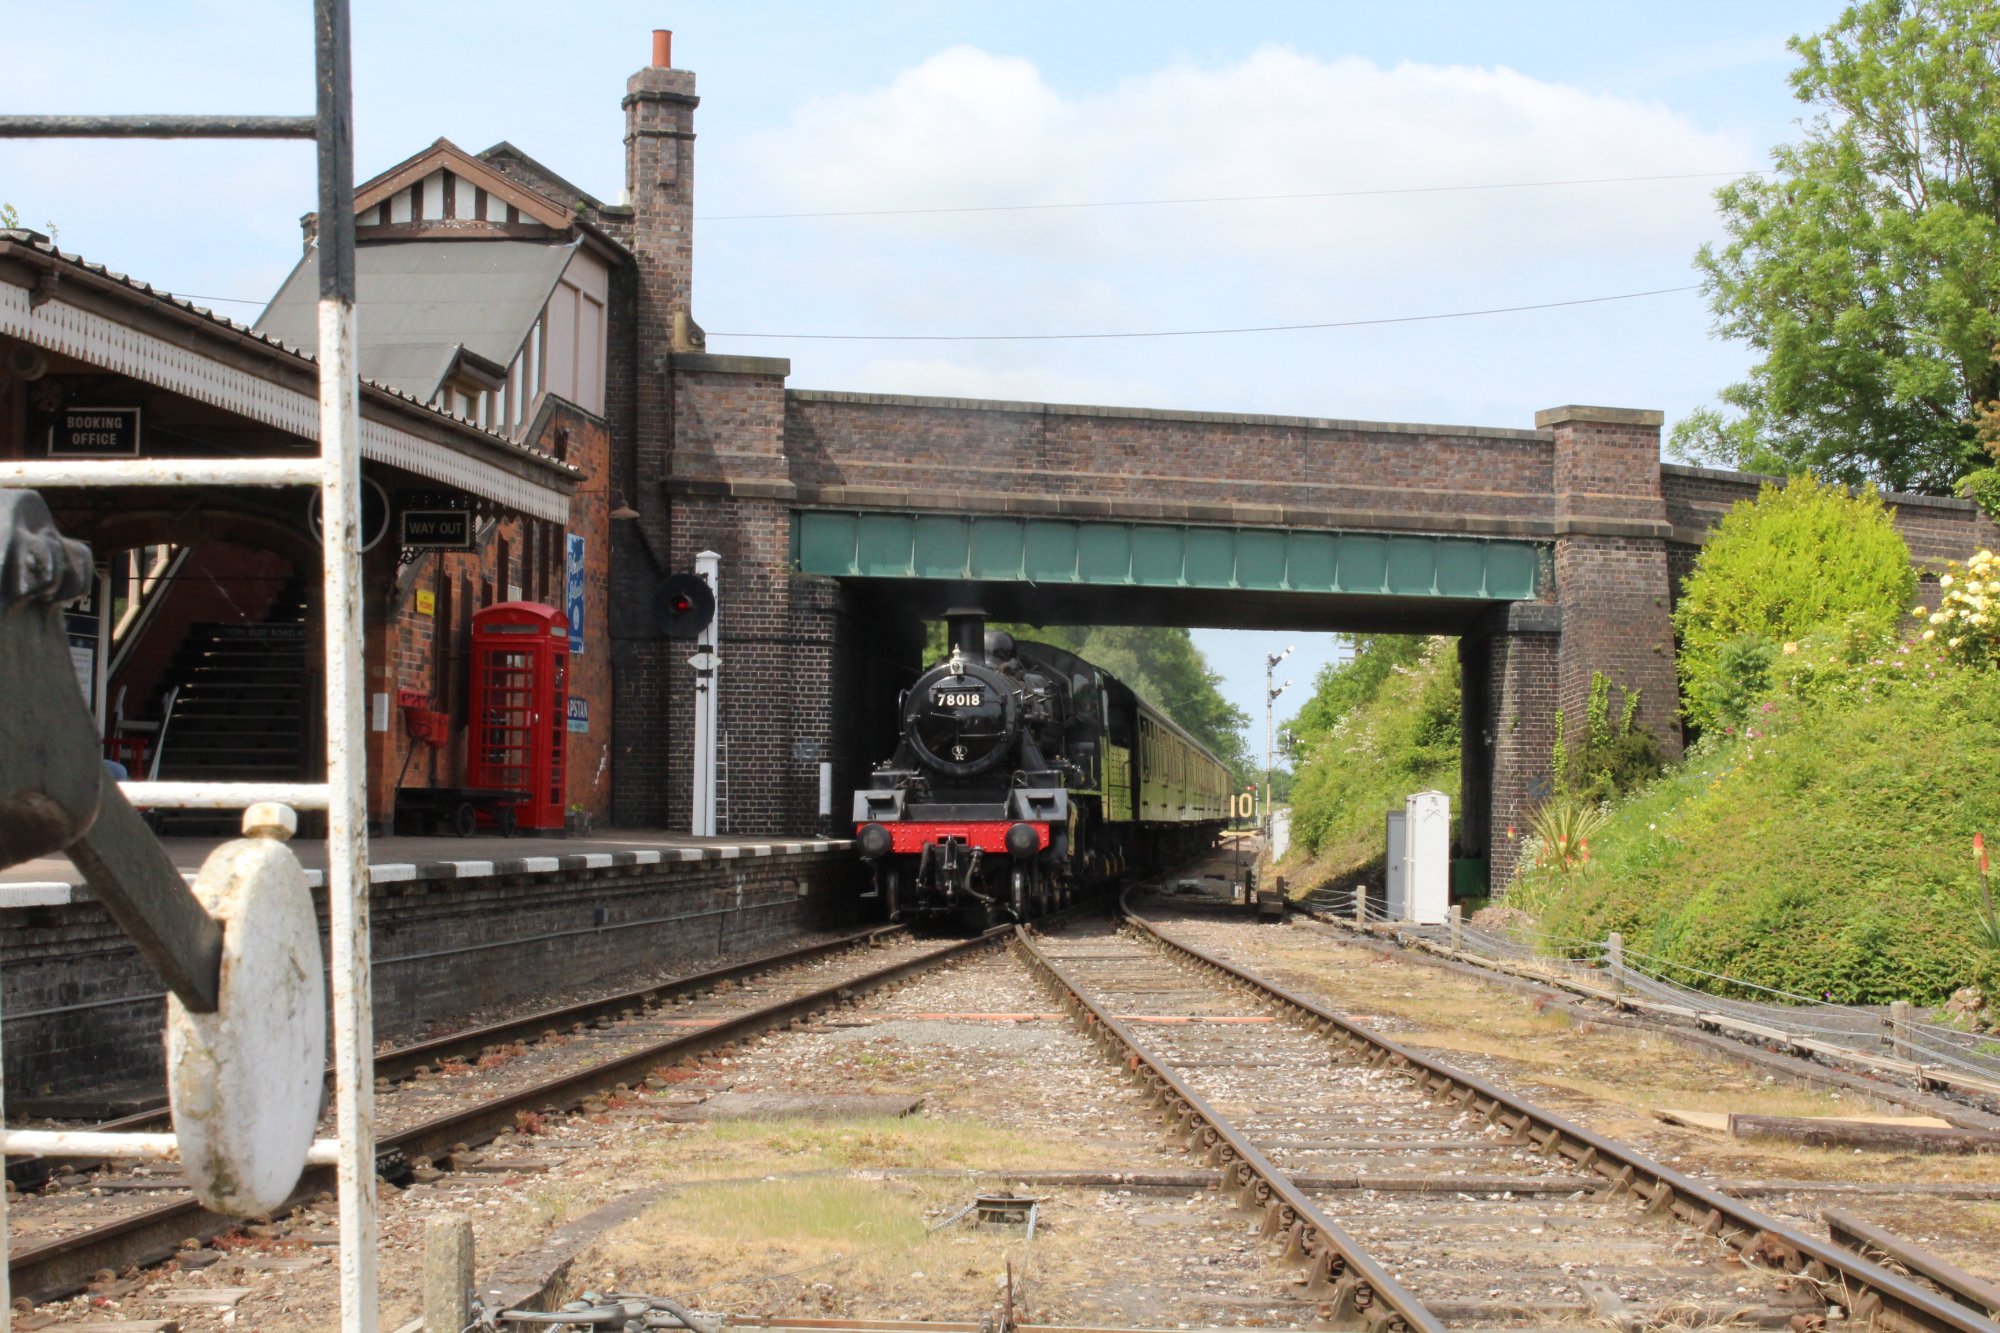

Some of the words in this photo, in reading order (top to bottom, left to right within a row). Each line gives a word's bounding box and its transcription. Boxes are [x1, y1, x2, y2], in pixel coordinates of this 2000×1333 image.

[67, 416, 123, 429] BOOKING
[72, 433, 117, 445] OFFICE
[409, 522, 435, 534] WAY
[440, 522, 463, 534] OUT
[937, 694, 980, 706] 78018
[1230, 793, 1253, 818] 10
